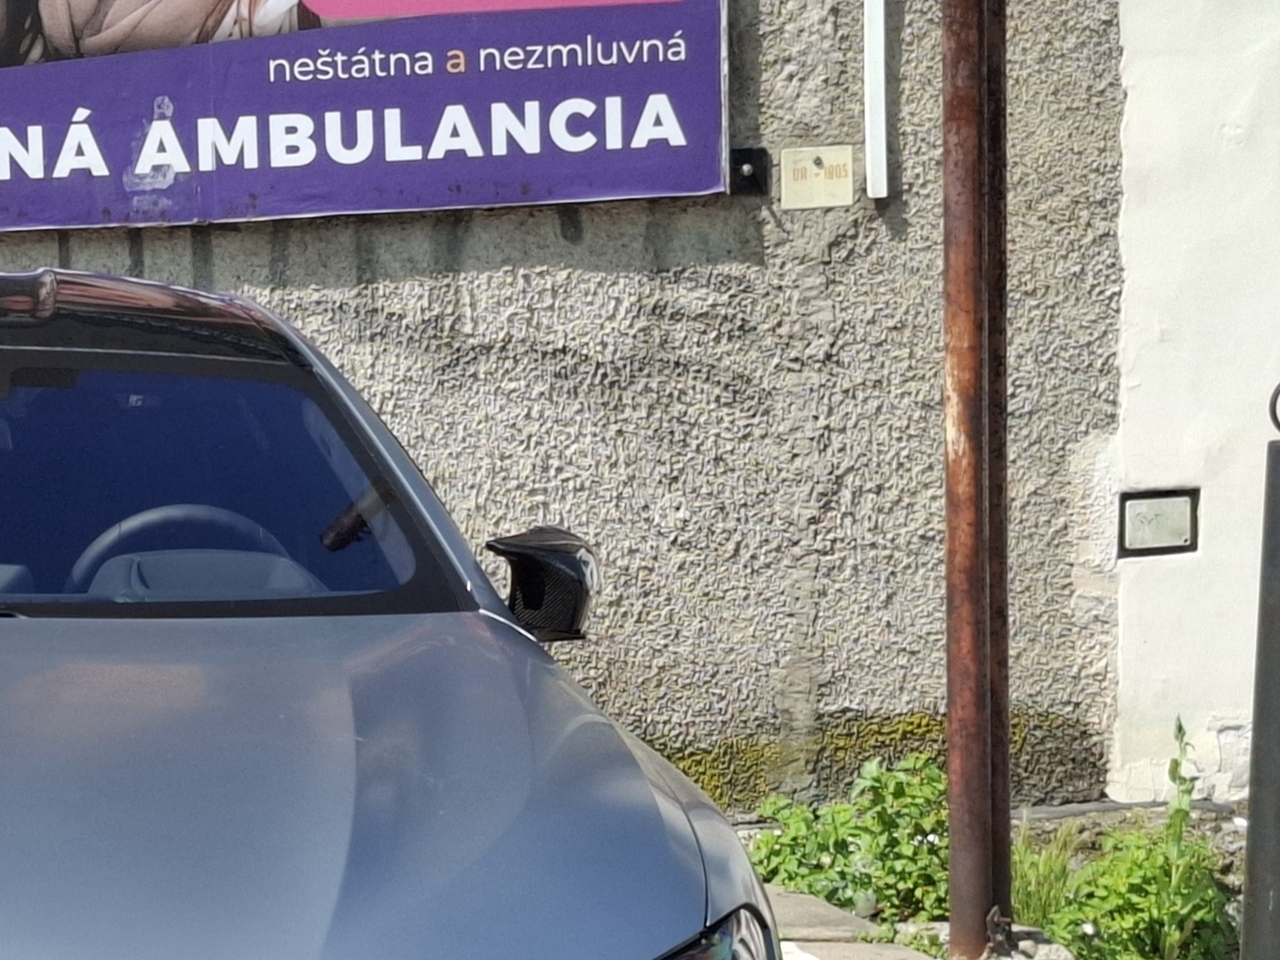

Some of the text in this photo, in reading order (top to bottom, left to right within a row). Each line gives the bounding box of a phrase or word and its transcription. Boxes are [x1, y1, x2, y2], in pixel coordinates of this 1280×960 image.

[270, 30, 685, 82] neštátna a nezmluvná
[134, 94, 687, 174] AMBULANCIA
